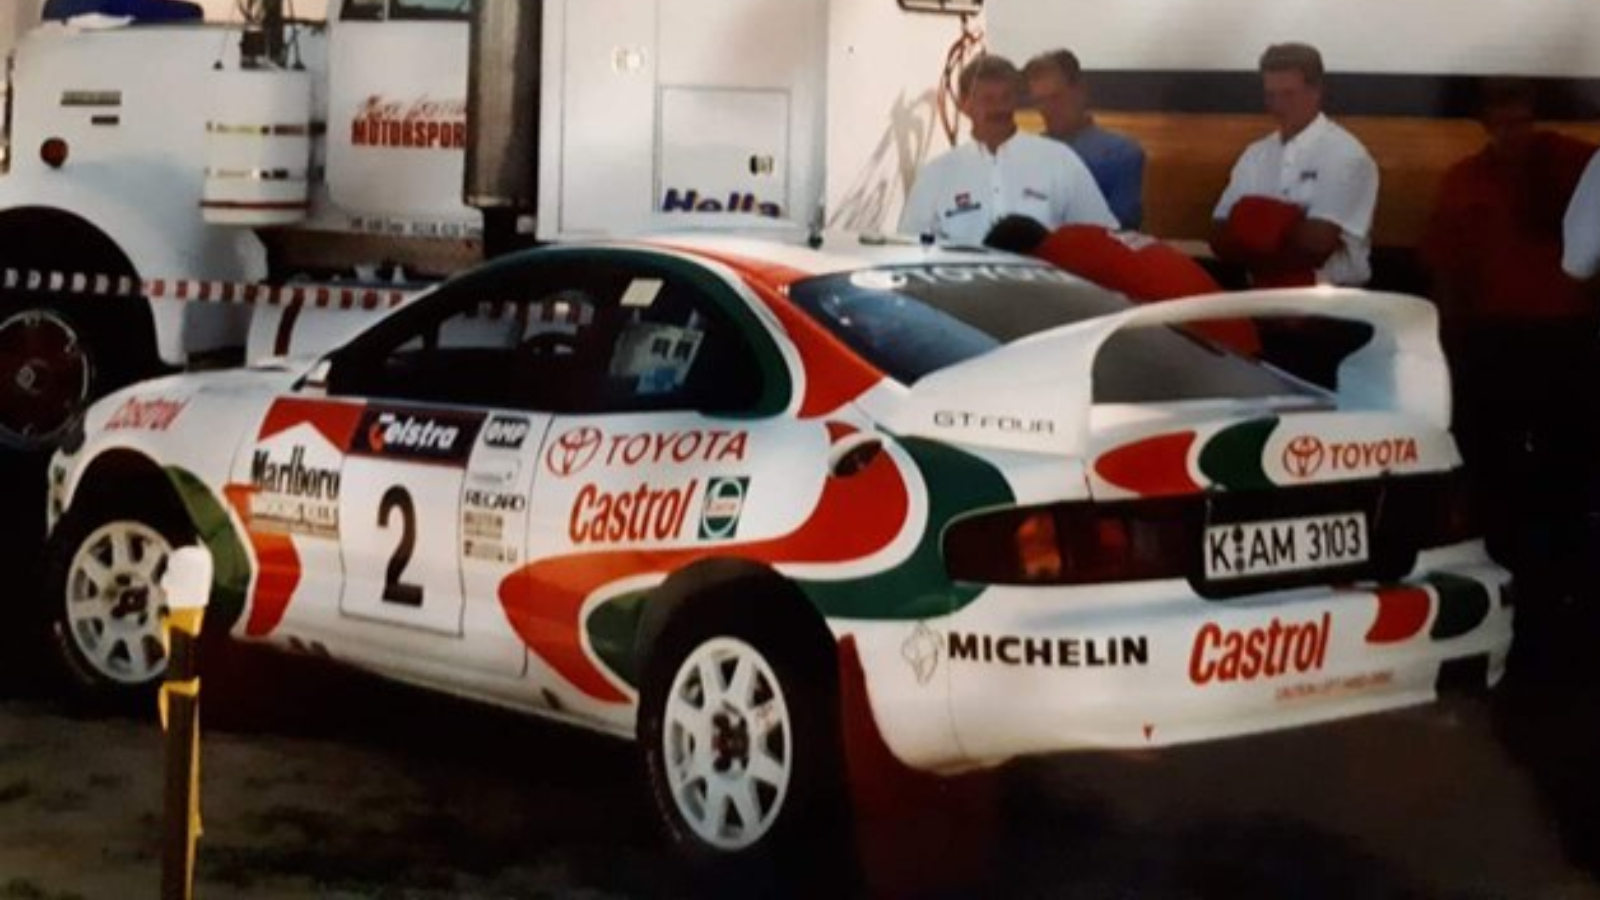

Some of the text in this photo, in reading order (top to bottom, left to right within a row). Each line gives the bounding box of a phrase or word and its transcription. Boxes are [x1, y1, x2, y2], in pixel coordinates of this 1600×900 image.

[352, 119, 467, 148] MOTORSPOR
[369, 412, 459, 452] Telstra
[605, 429, 748, 465] TOYOTA
[251, 446, 341, 500] Marlboro
[1329, 439, 1418, 469] TOYOTA
[569, 478, 698, 543] Castrol
[377, 484, 424, 608] 2
[1306, 517, 1362, 561] 3103
[947, 631, 1149, 667] MICHELIN
[1188, 610, 1331, 685] Castrol
